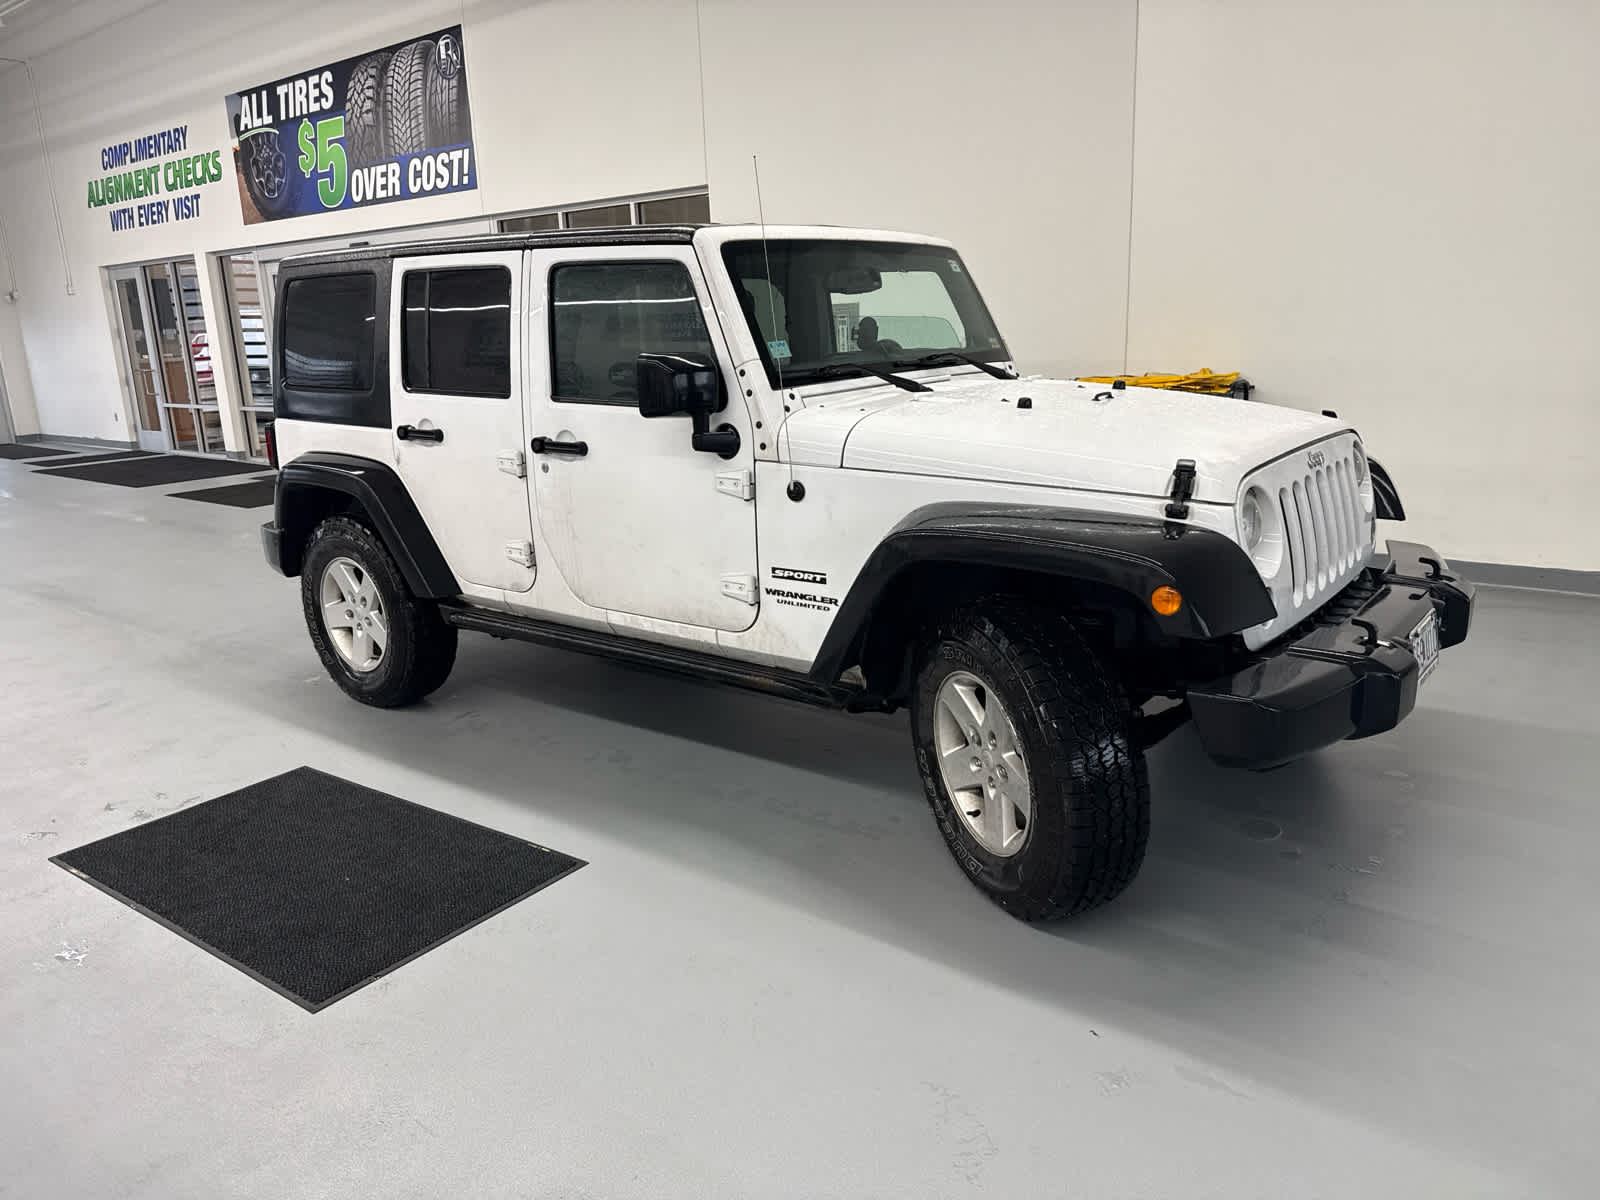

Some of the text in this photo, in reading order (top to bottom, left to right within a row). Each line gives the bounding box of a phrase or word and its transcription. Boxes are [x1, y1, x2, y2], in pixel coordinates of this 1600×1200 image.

[240, 71, 334, 131] ALL TIRES
[101, 125, 188, 171] COMPLIMENTARY
[298, 116, 347, 208] $5
[87, 150, 222, 208] ALIGNMENT CHECKS
[351, 148, 470, 203] OVER COST!
[109, 194, 201, 232] WITH EVERY VISIT
[765, 588, 839, 606] WRANGLER
[774, 569, 823, 582] SPORT
[776, 599, 830, 611] UNLIMITED
